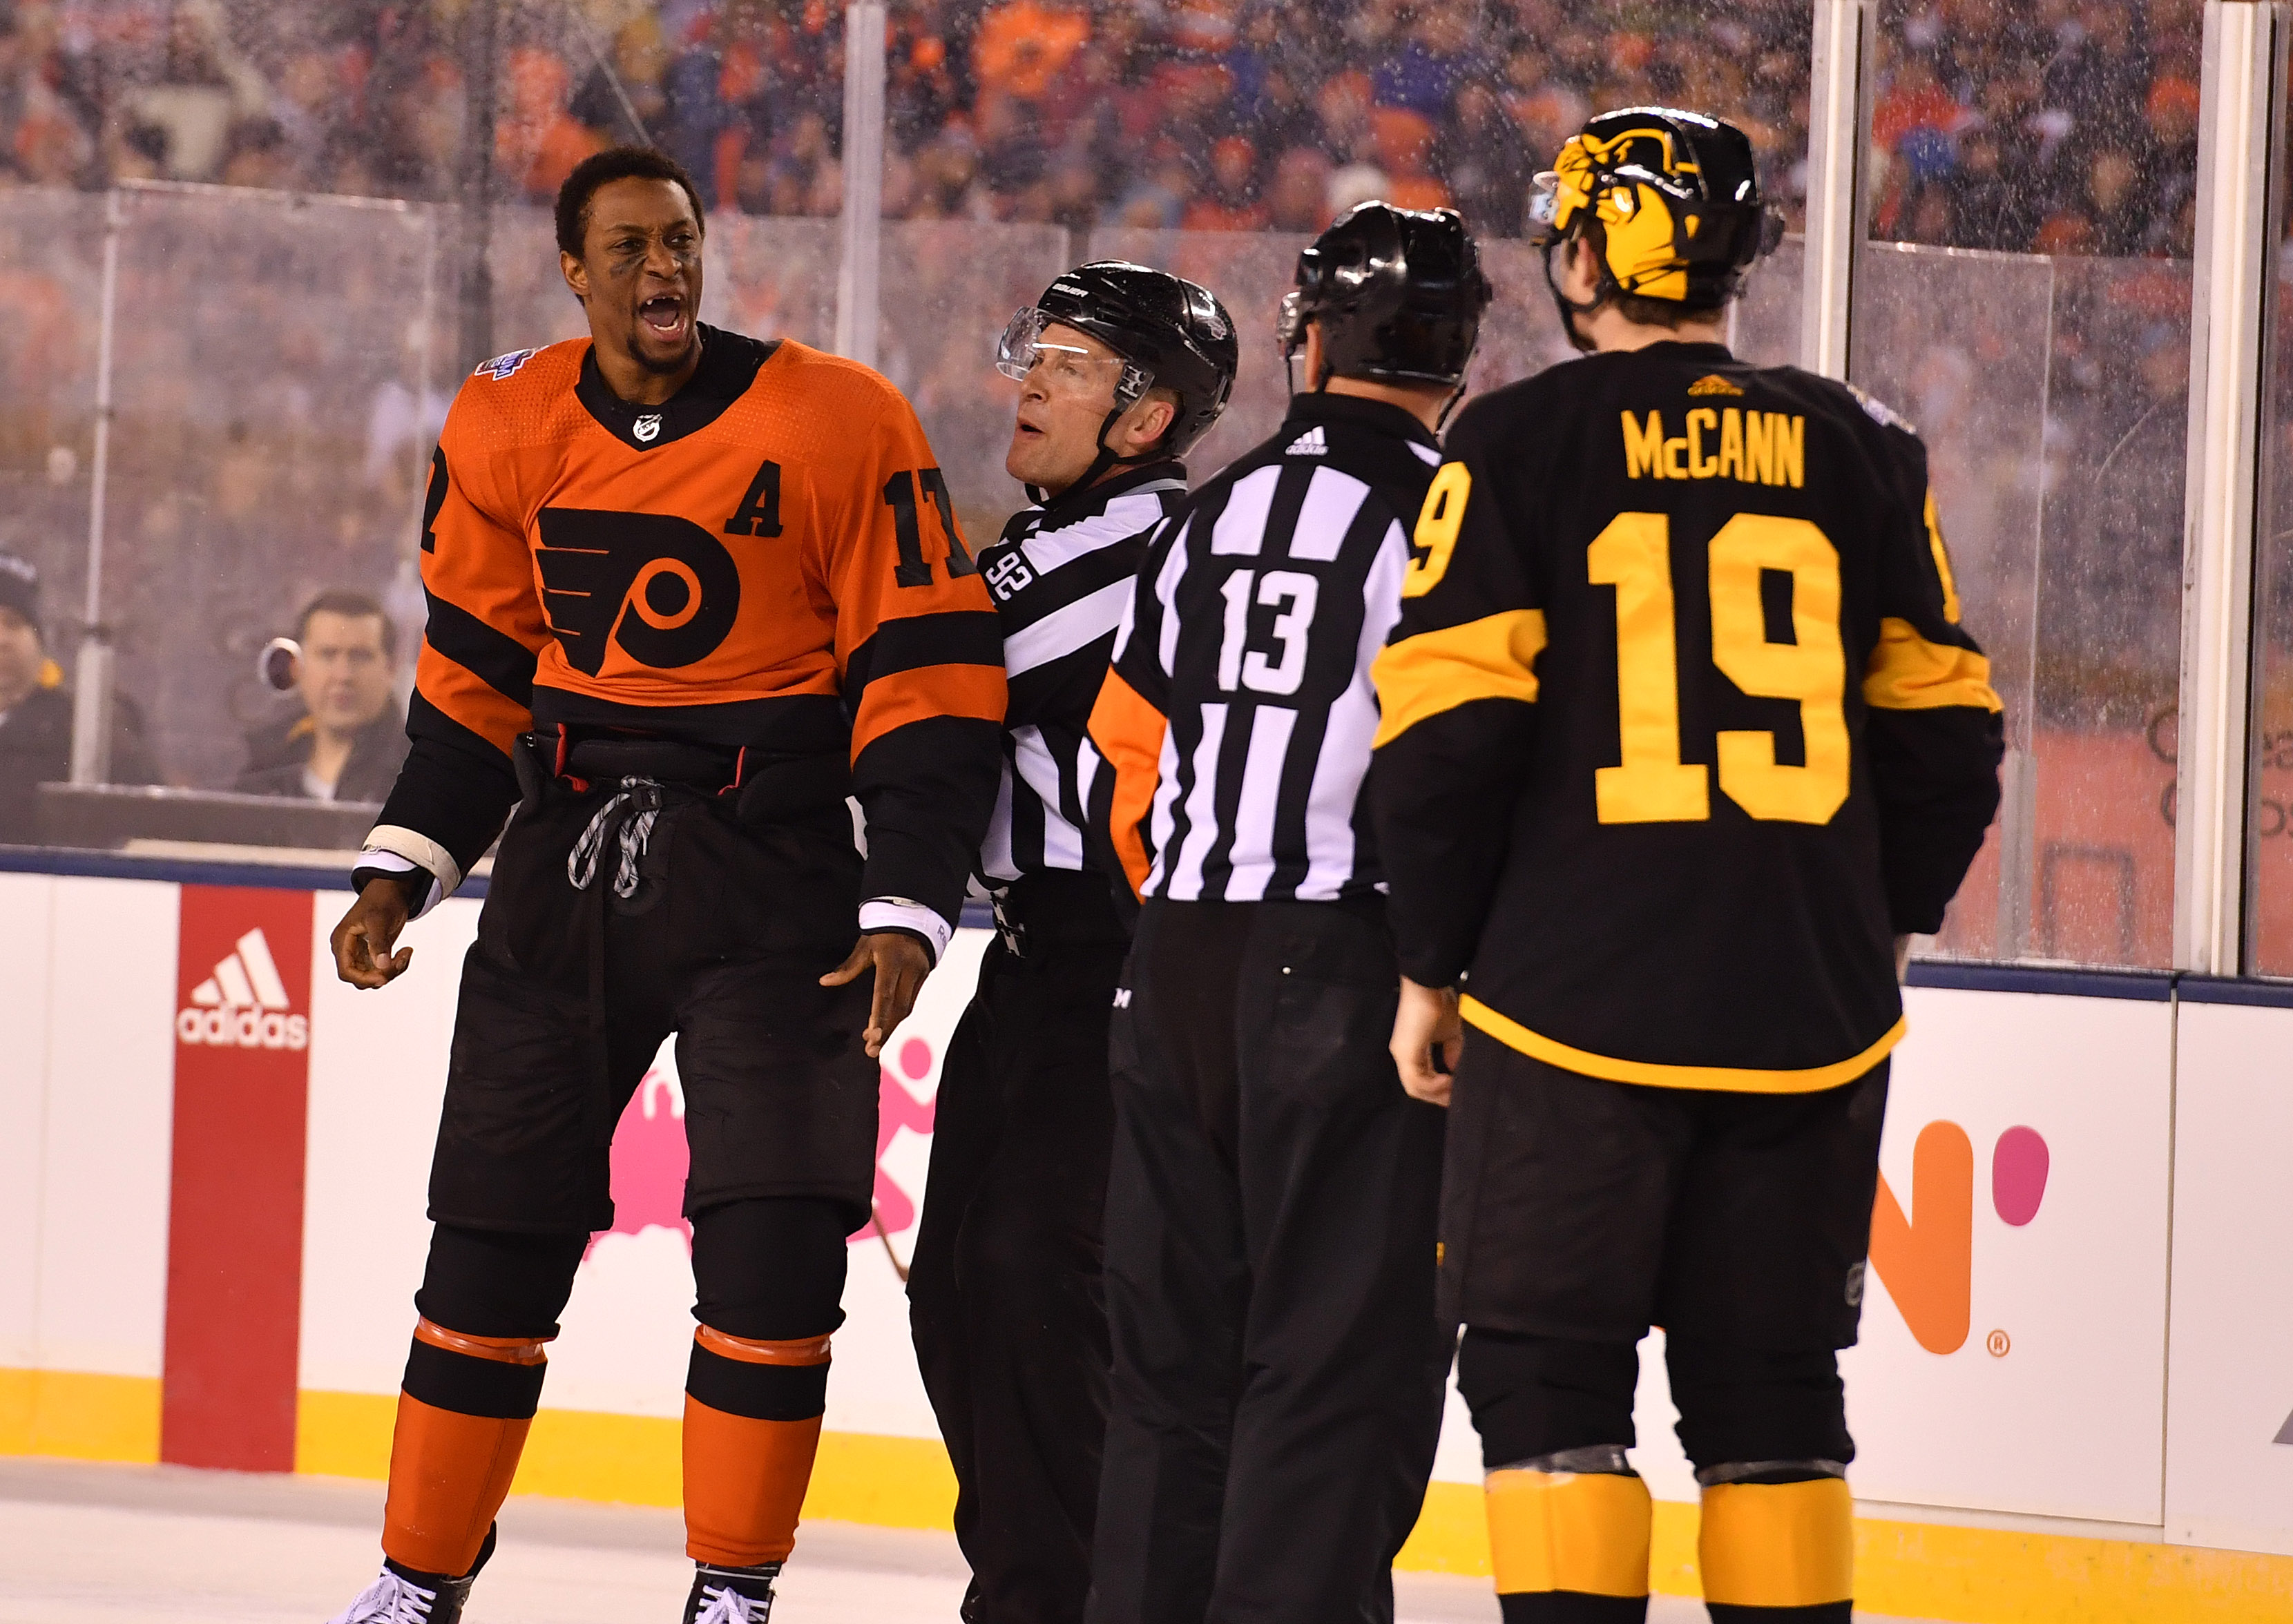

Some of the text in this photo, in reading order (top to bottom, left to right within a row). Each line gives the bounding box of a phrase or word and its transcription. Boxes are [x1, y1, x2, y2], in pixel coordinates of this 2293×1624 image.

[1622, 407, 1804, 487] McCANN
[724, 459, 783, 537] A
[883, 467, 979, 588] 17
[985, 552, 1033, 601] 92
[1218, 568, 1318, 695] 13
[1587, 512, 1850, 824] 19
[178, 1004, 307, 1049] adidas
